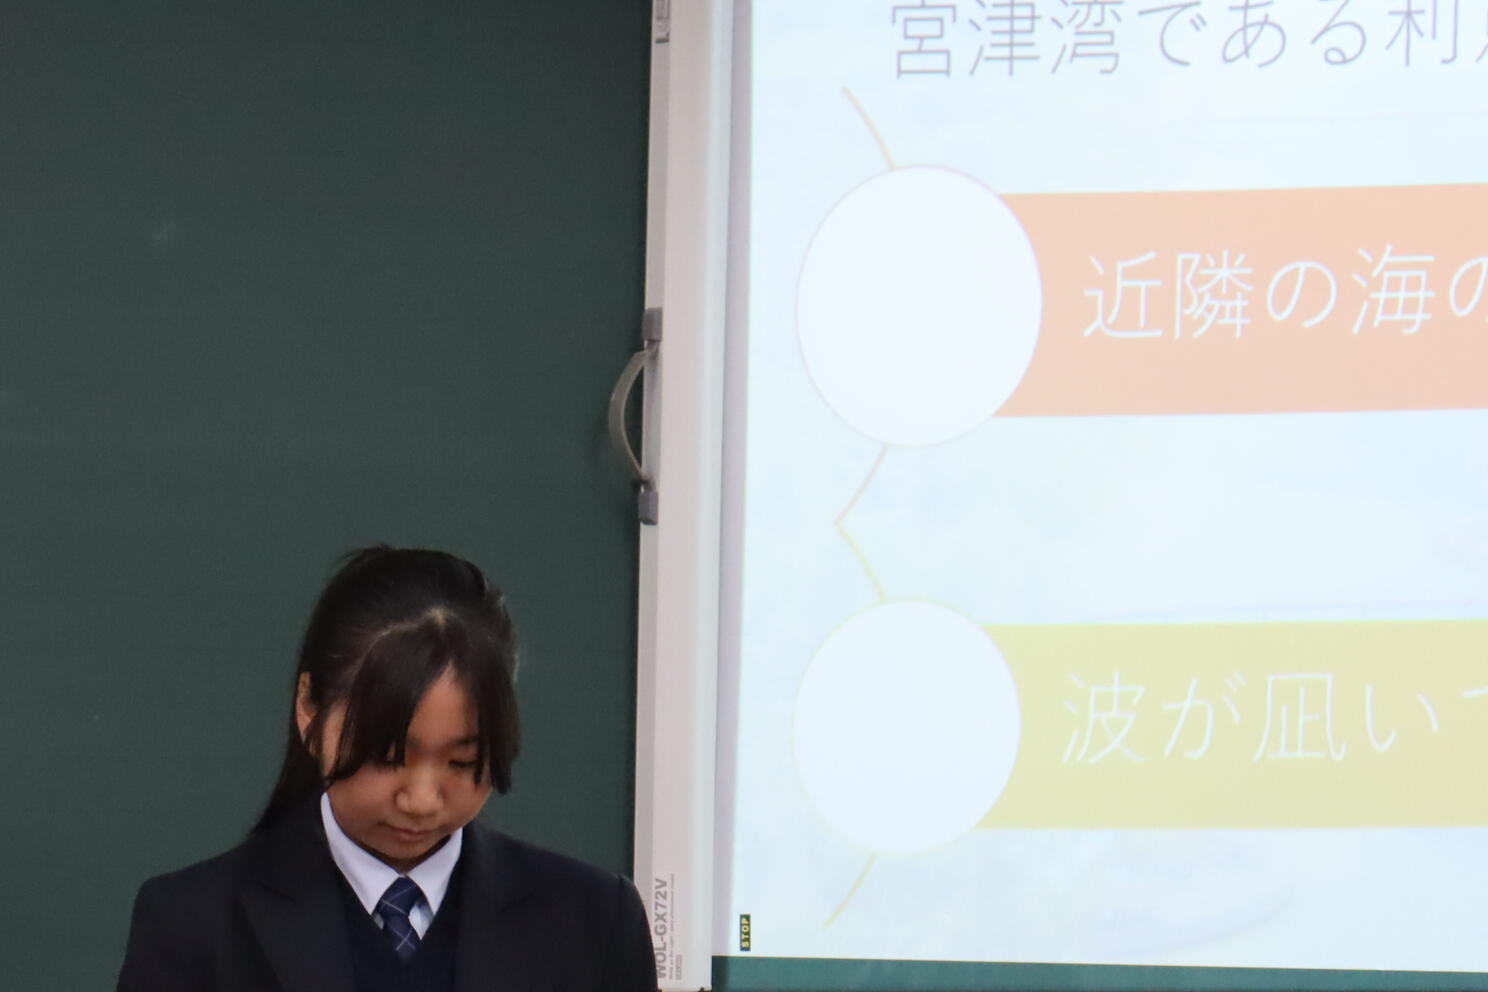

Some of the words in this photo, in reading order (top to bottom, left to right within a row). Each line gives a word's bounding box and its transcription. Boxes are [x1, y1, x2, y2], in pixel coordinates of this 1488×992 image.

[891, 0, 1488, 79] 宮津湾である利
[741, 917, 750, 949] STOP
